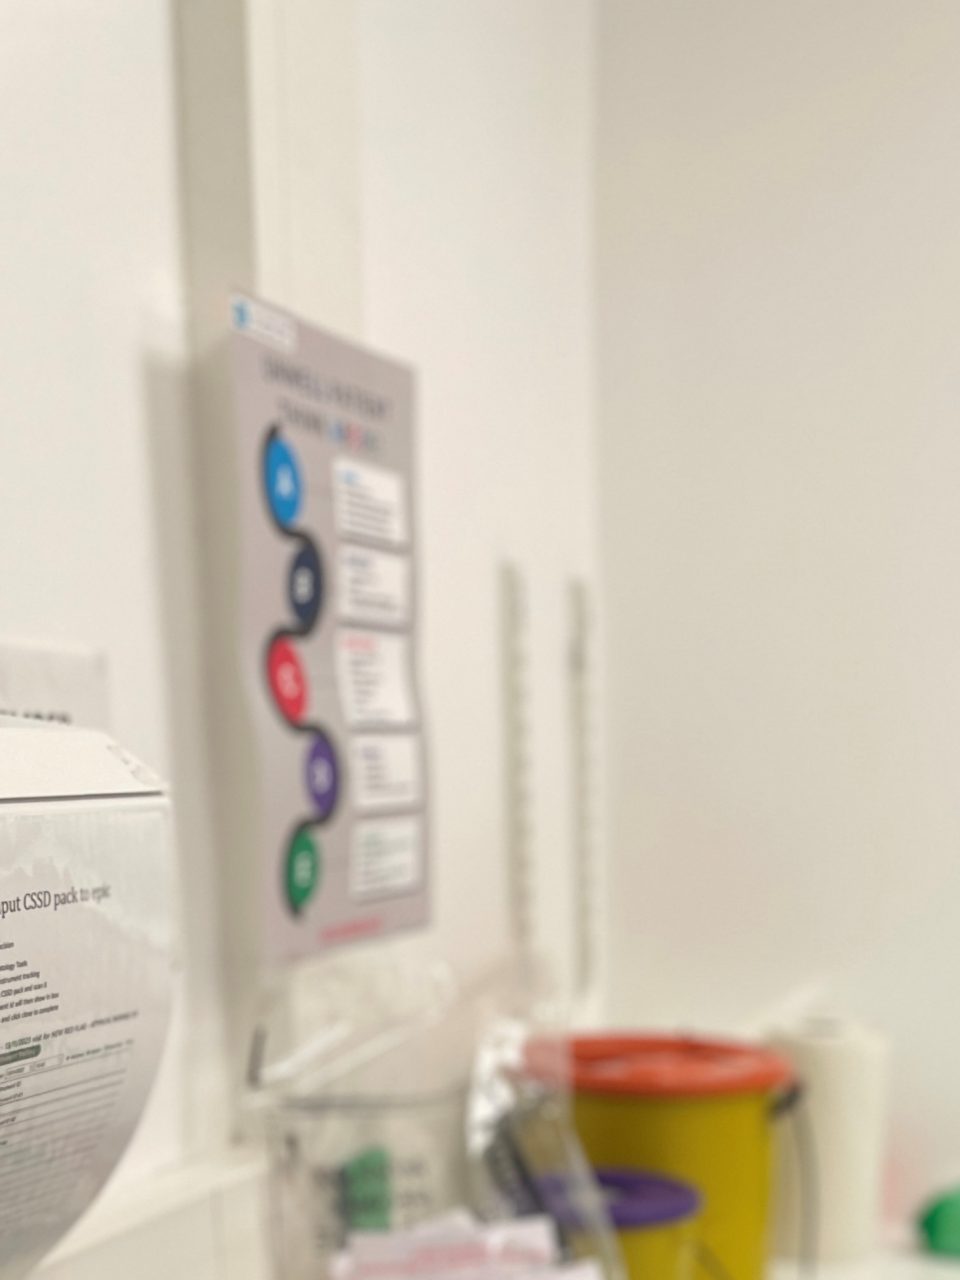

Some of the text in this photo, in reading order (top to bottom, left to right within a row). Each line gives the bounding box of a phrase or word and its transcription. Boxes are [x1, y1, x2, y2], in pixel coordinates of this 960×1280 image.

[0, 896, 21, 919] put
[23, 890, 51, 911] CSSD
[54, 886, 78, 911] pack
[80, 887, 89, 902] to
